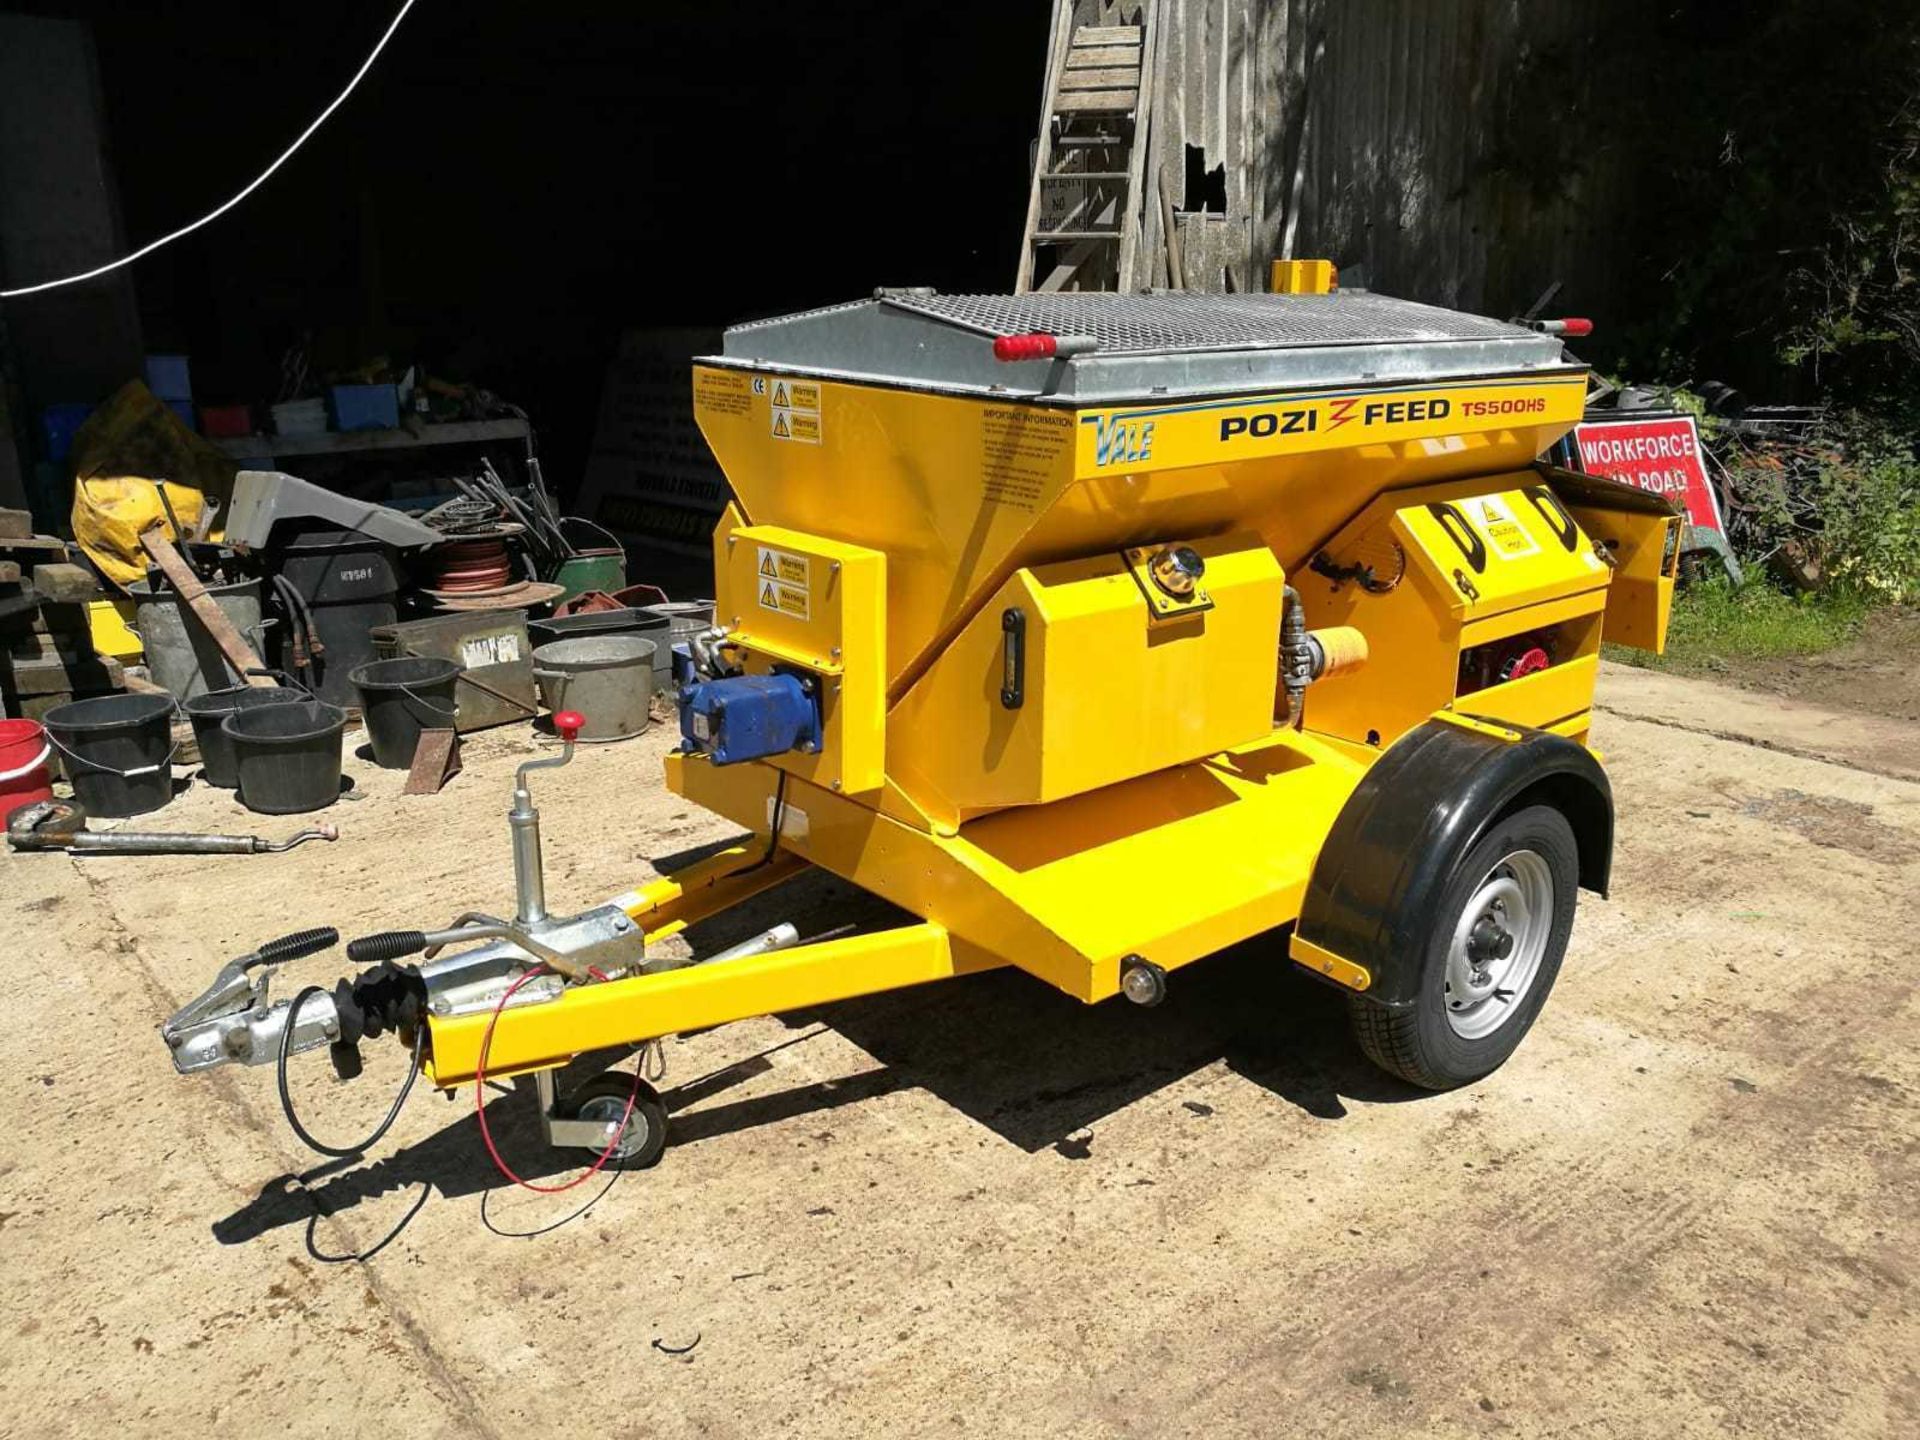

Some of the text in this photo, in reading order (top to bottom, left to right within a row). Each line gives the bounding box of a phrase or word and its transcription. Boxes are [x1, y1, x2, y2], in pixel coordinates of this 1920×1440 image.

[983, 408, 1073, 428] IMPORTANT INFORMATION
[1220, 398, 1546, 441] POZI FEED TS500HS
[1582, 433, 1693, 465] WORKFORCE
[1638, 469, 1687, 493] ROAD
